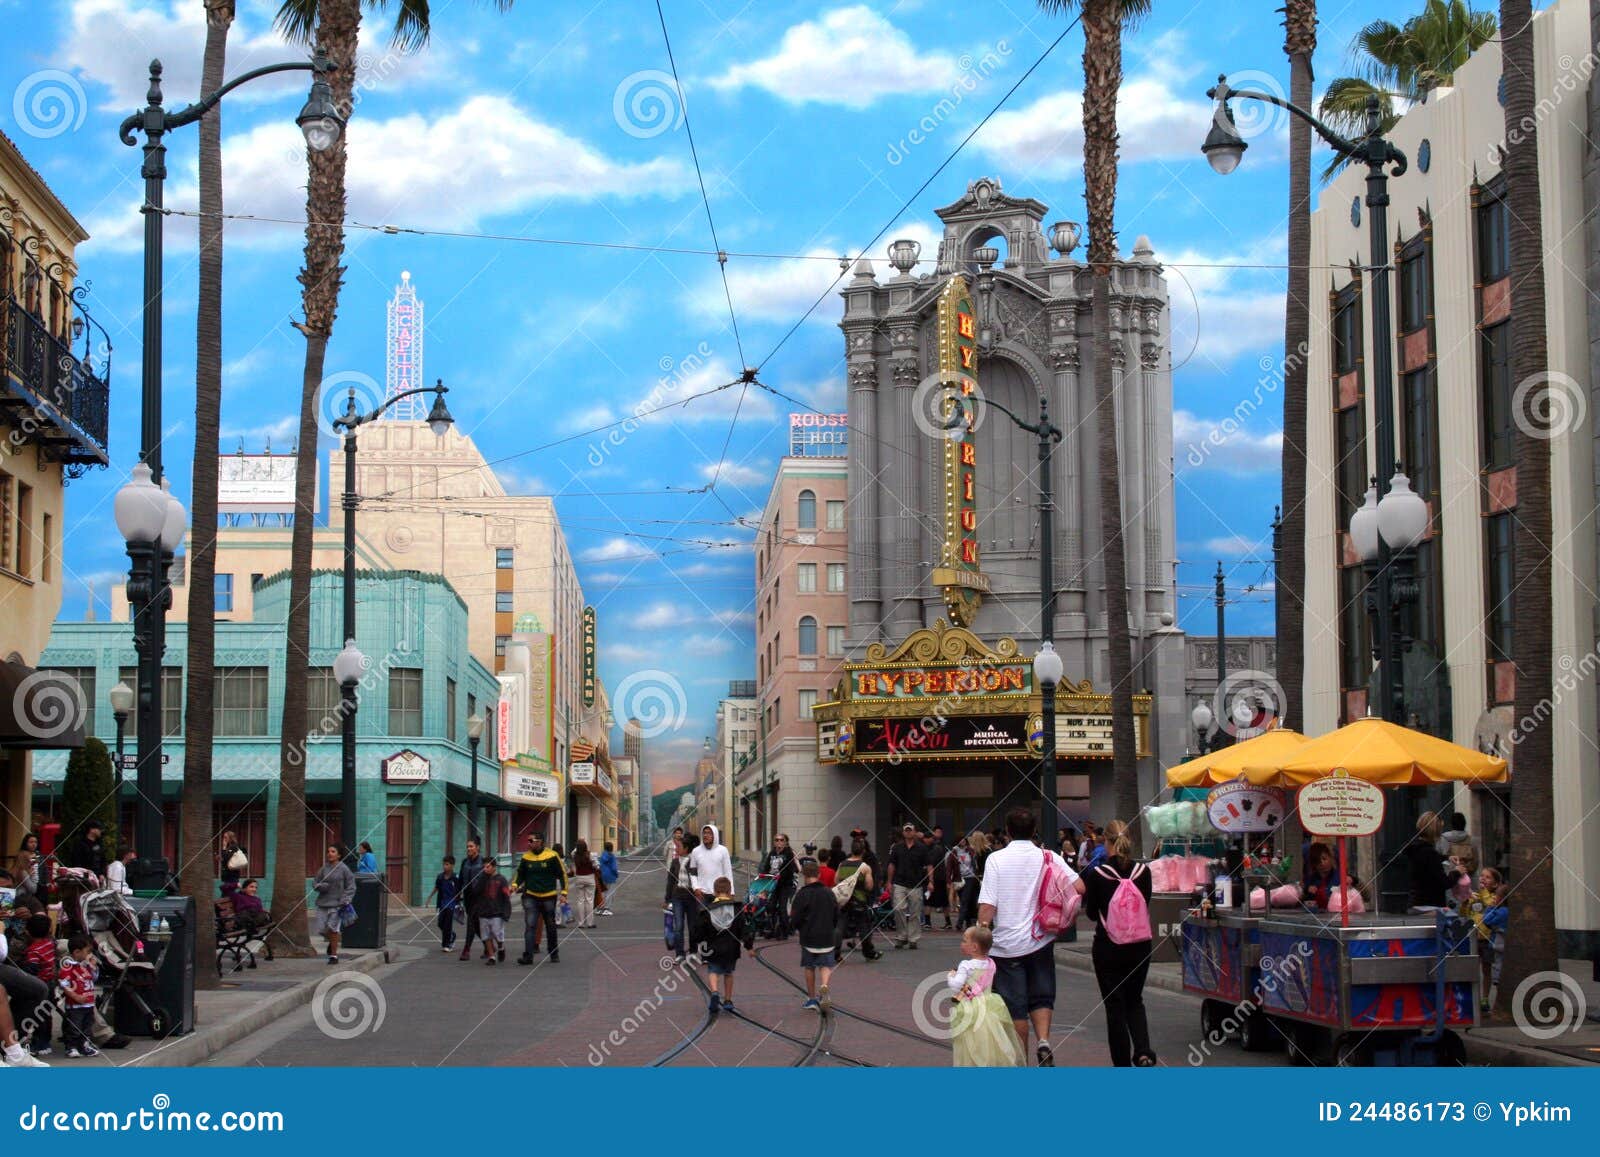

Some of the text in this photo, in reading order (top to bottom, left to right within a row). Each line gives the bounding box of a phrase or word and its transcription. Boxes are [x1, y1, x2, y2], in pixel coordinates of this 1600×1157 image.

[789, 413, 848, 427] ROOSE
[810, 432, 848, 444] HOT
[585, 625, 594, 698] CAPITAN
[857, 668, 1025, 695] HYPERION
[1214, 784, 1247, 800] FROZEN
